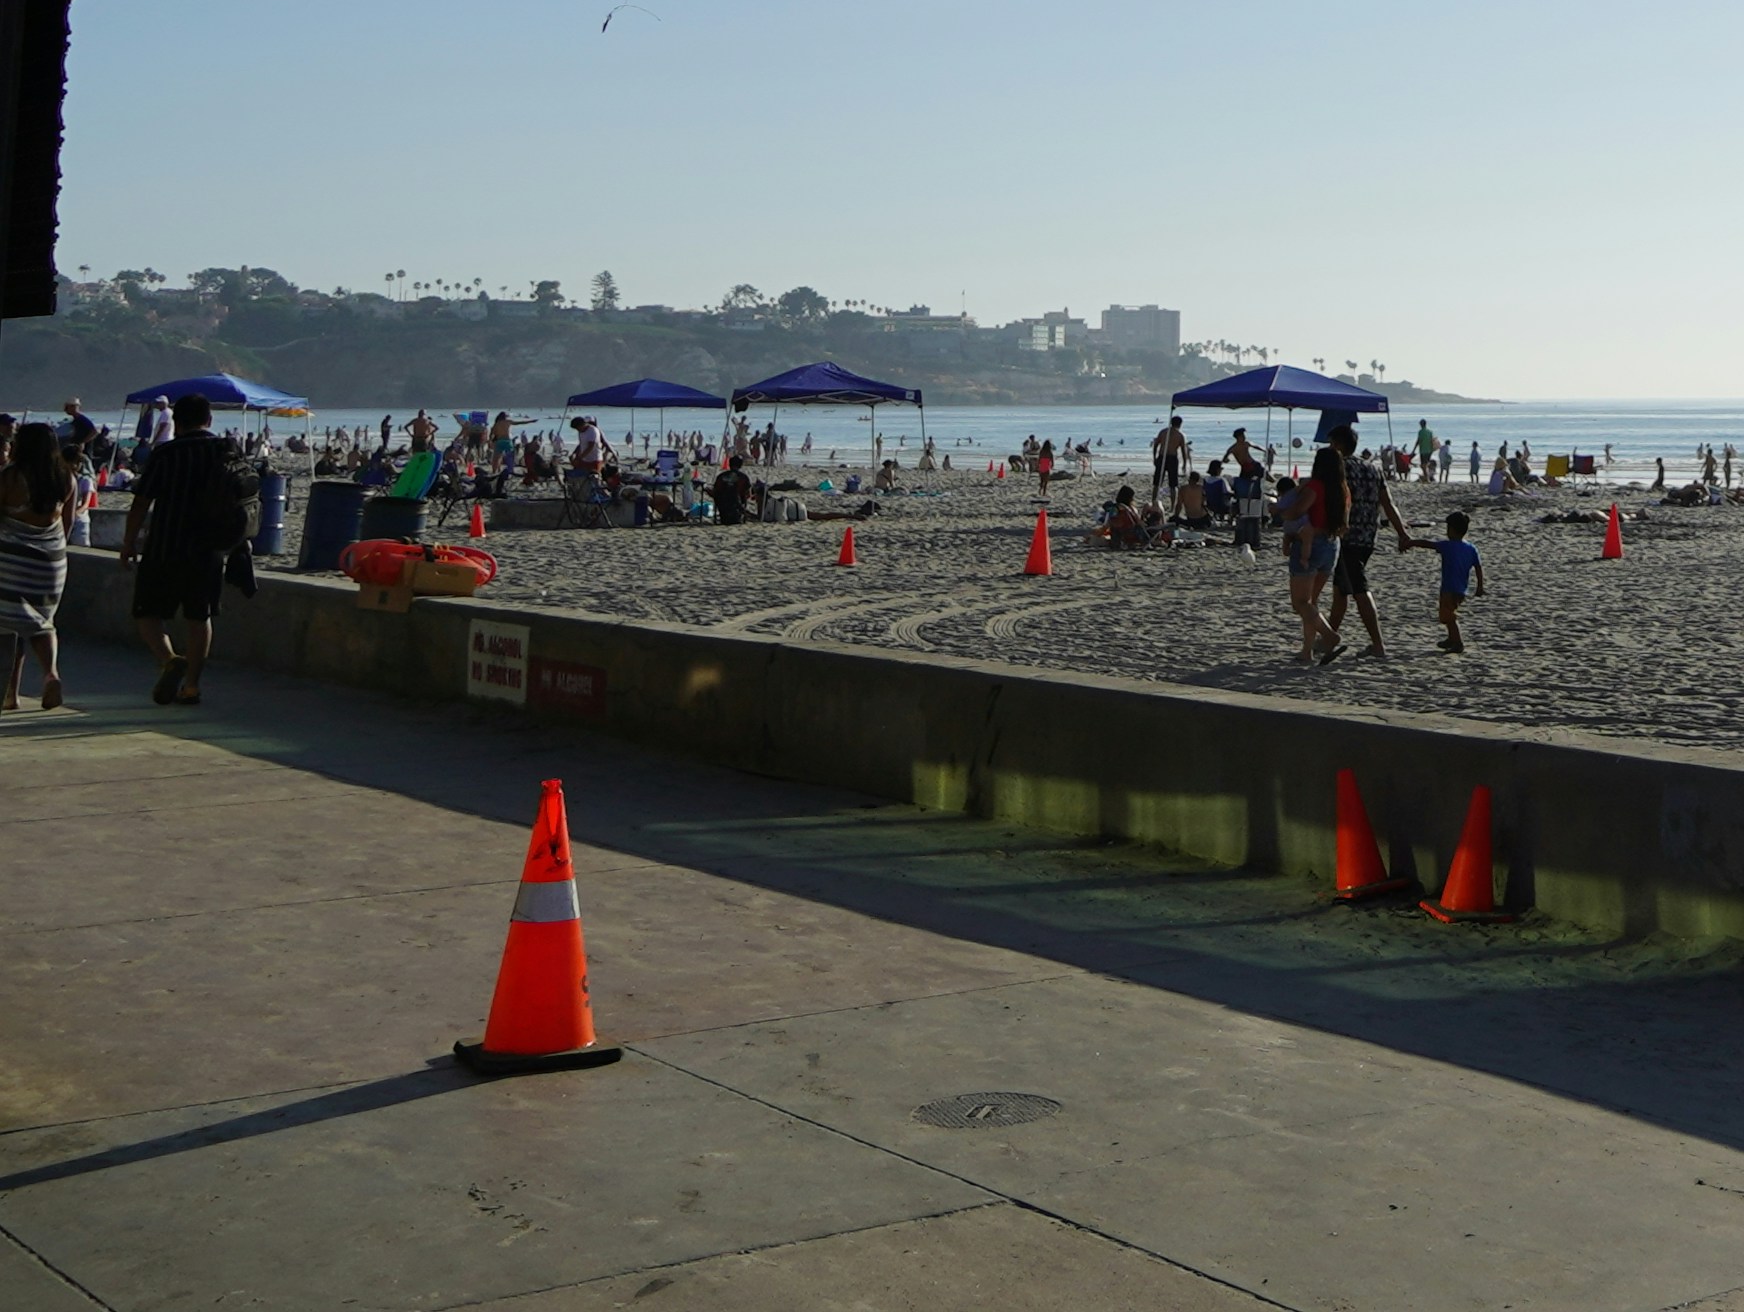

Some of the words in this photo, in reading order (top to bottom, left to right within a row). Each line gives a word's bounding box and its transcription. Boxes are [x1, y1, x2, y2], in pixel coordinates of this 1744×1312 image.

[488, 634, 522, 659] ALCOHOL
[472, 661, 482, 681] NO
[487, 664, 522, 689] SMOKING
